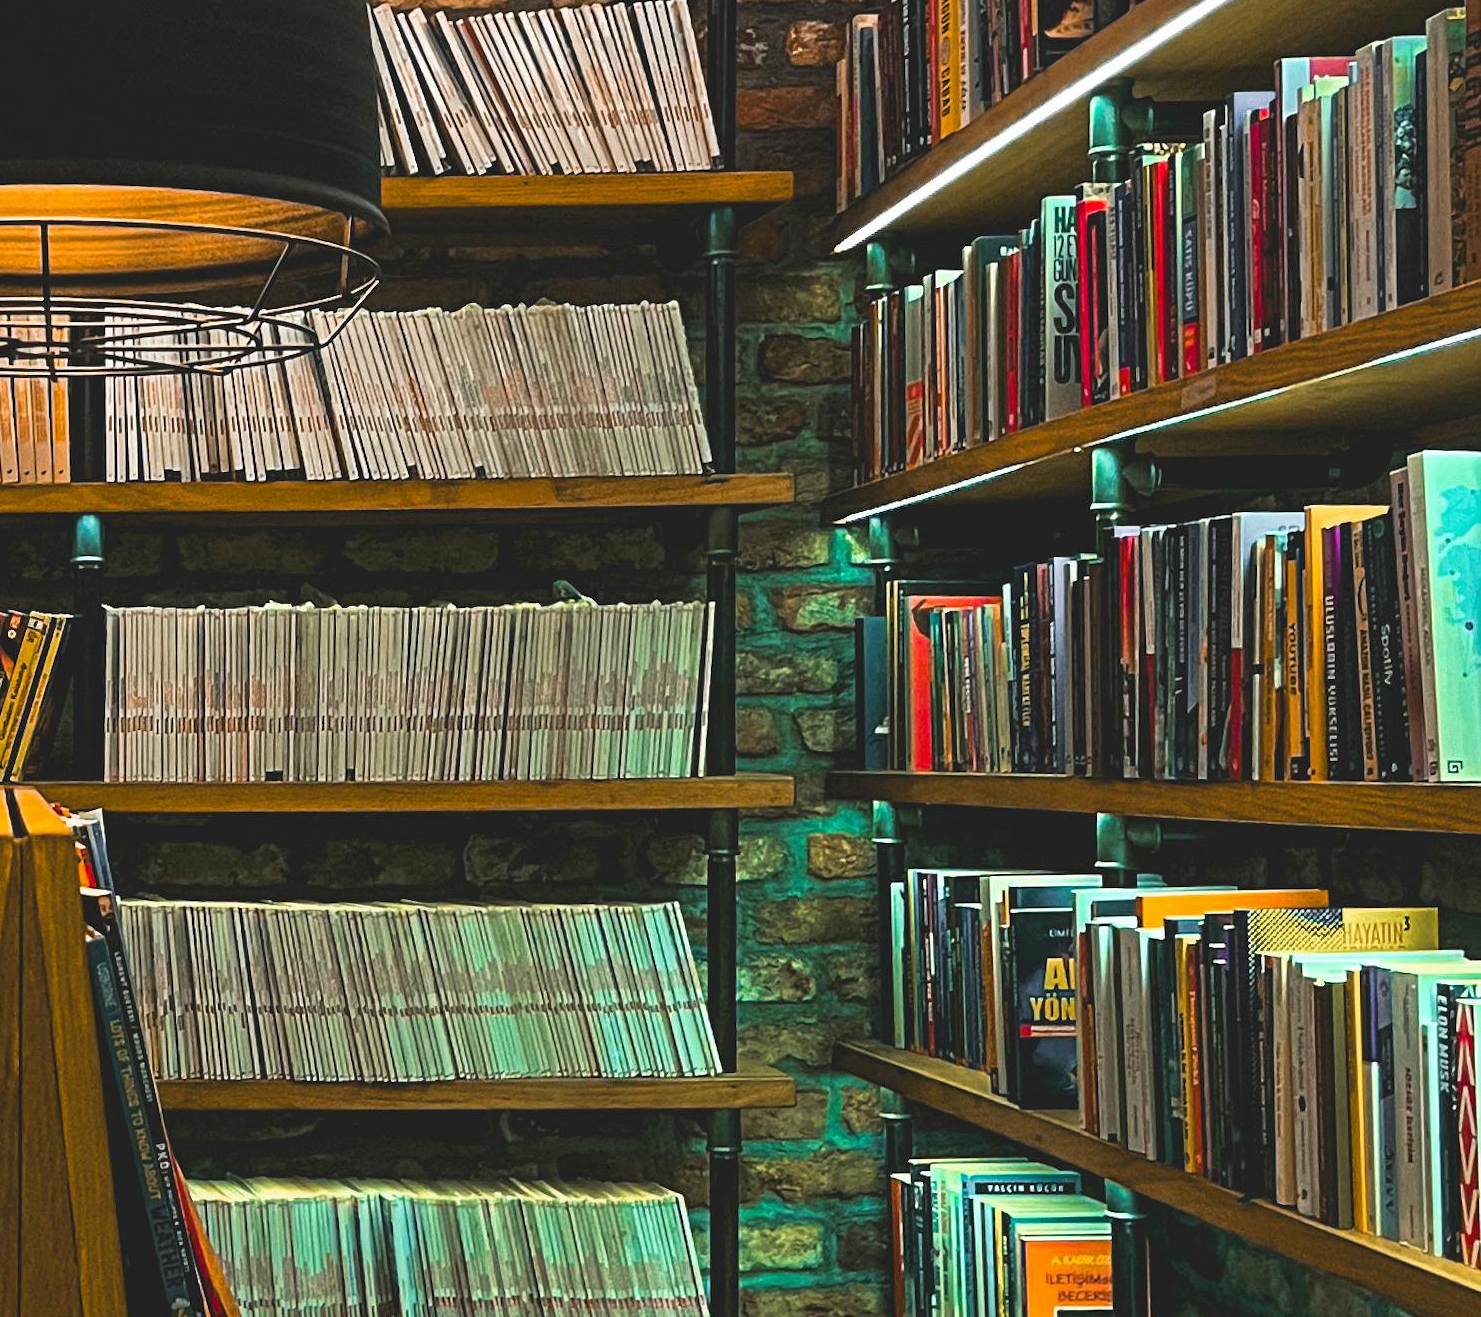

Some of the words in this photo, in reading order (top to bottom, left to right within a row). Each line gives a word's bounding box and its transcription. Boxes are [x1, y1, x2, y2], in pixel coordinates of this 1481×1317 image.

[1436, 994, 1449, 1029] ELON
[1438, 1030, 1452, 1093] MUSK
[109, 1018, 126, 1048] LOTS
[120, 1065, 140, 1108] THINGS
[150, 1203, 185, 1288] WEATHER
